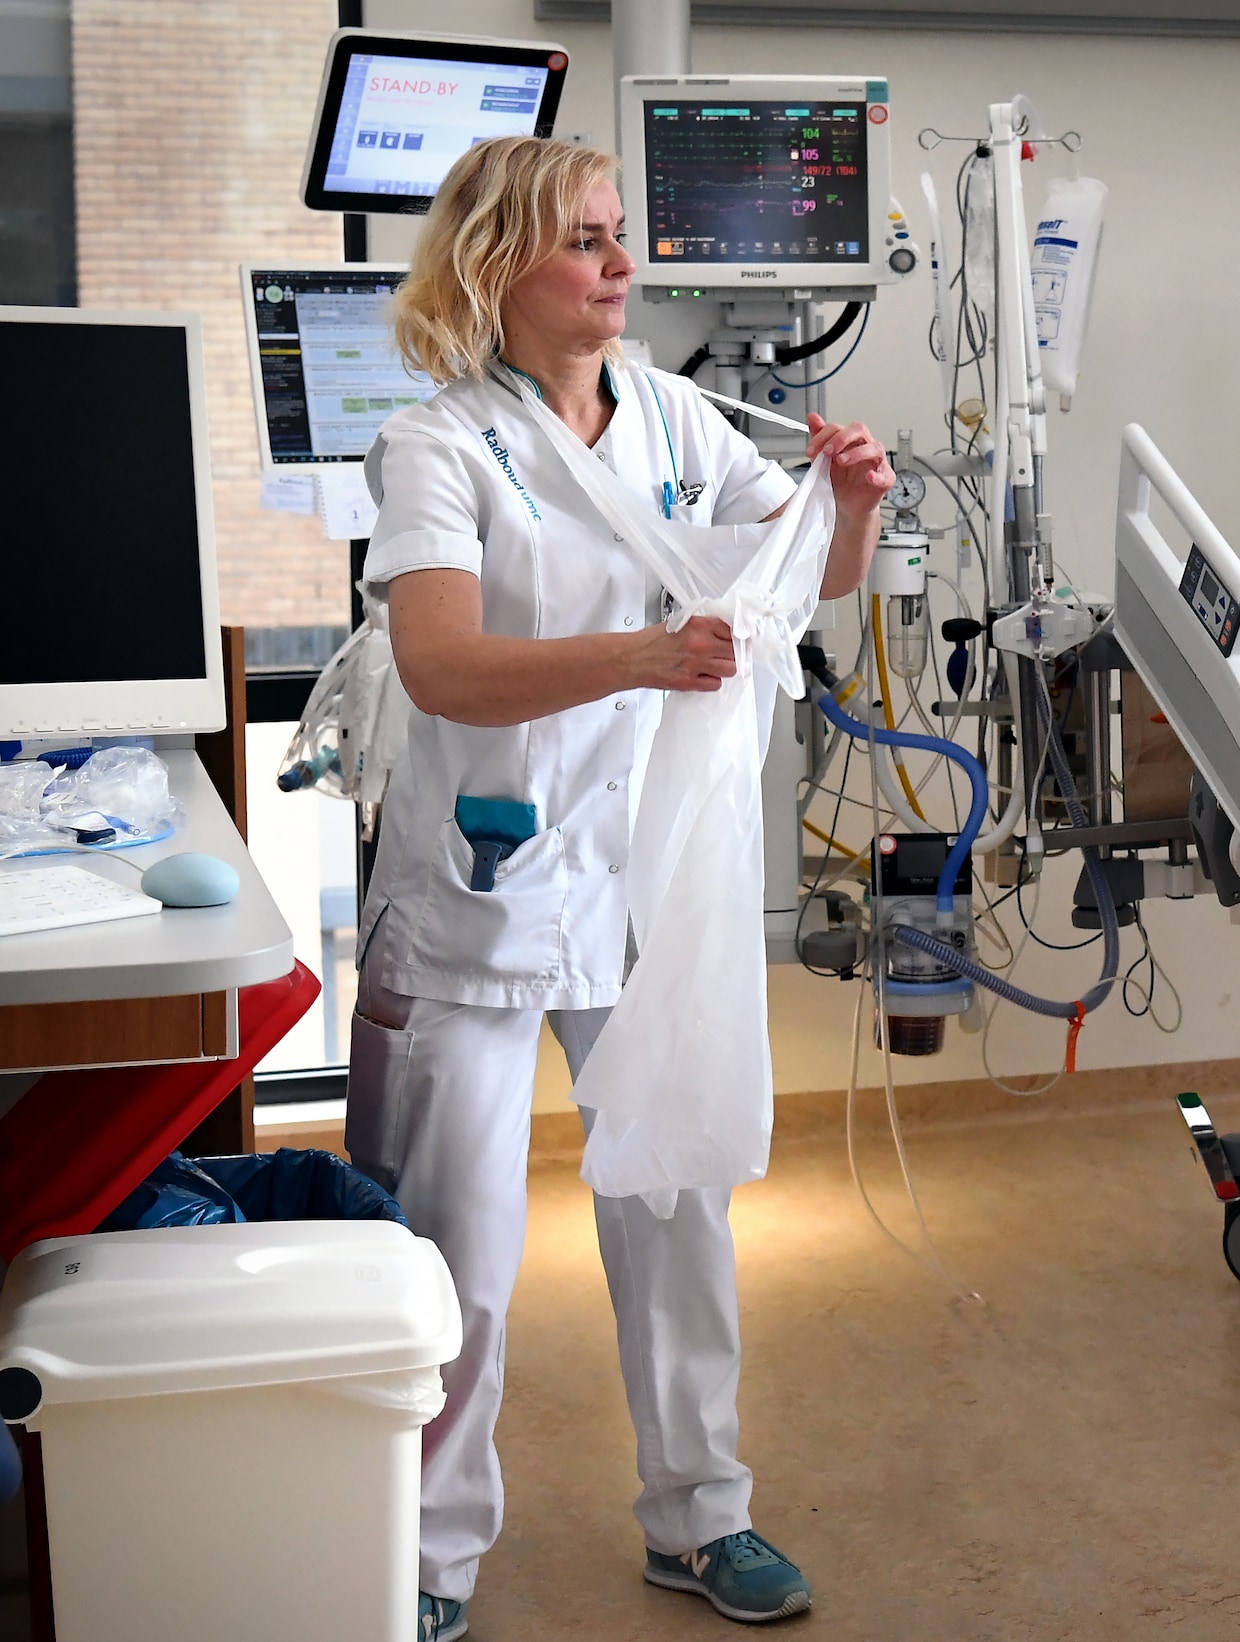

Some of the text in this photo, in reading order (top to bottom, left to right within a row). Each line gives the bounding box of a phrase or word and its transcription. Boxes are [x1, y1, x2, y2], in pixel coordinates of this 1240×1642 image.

[369, 76, 459, 97] STAND-BY
[802, 127, 820, 139] 104
[801, 148, 819, 161] 105
[801, 175, 816, 188] 23
[802, 199, 817, 212] 99
[740, 270, 778, 279] PHILIPS
